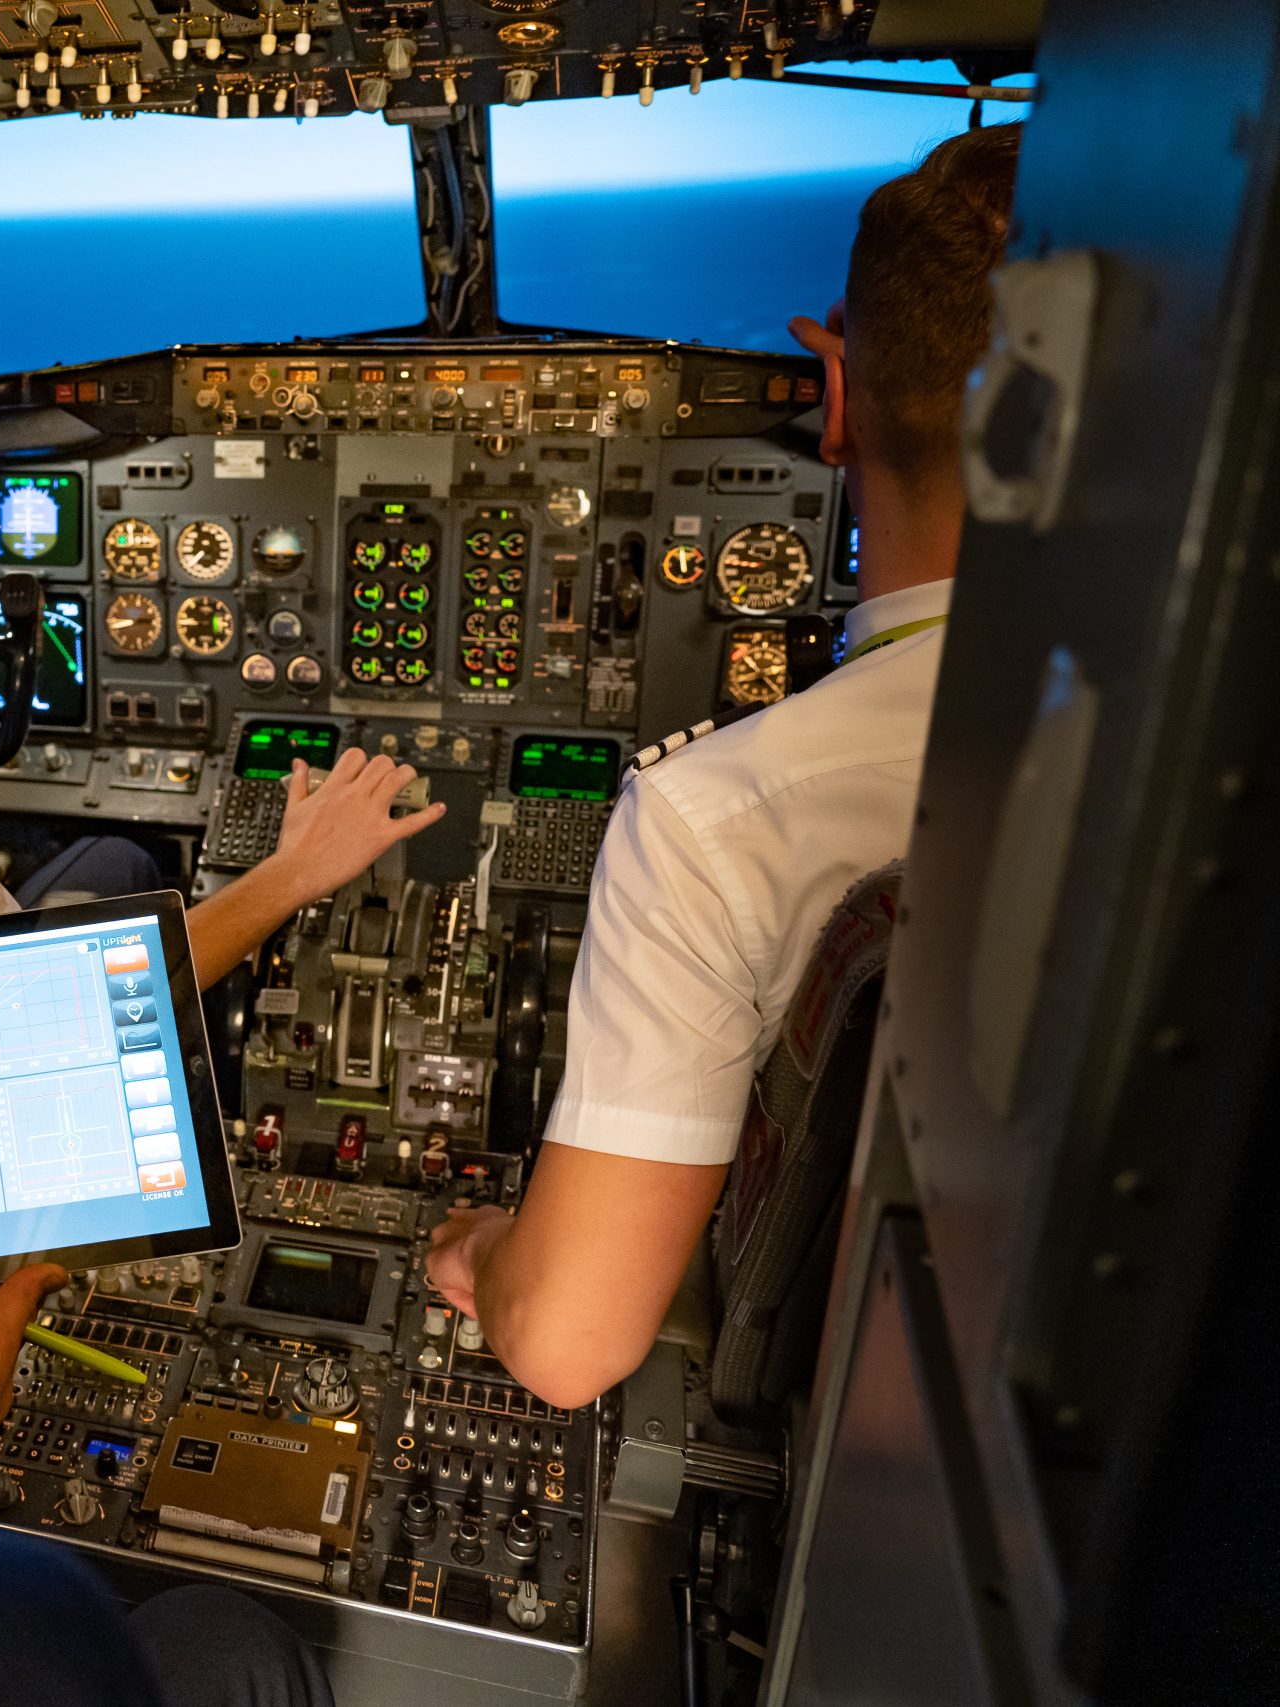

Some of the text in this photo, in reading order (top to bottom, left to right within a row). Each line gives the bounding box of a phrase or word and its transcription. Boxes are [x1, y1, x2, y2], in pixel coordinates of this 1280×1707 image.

[263, 1115, 276, 1136] 1
[429, 1137, 446, 1152] 2
[142, 1191, 171, 1201] LICENSE
[64, 1424, 71, 1432] 3
[234, 1433, 302, 1451] DATA PRINTER
[407, 1559, 424, 1567] TRIM
[485, 1574, 501, 1582] FLT
[504, 1577, 515, 1585] DK
